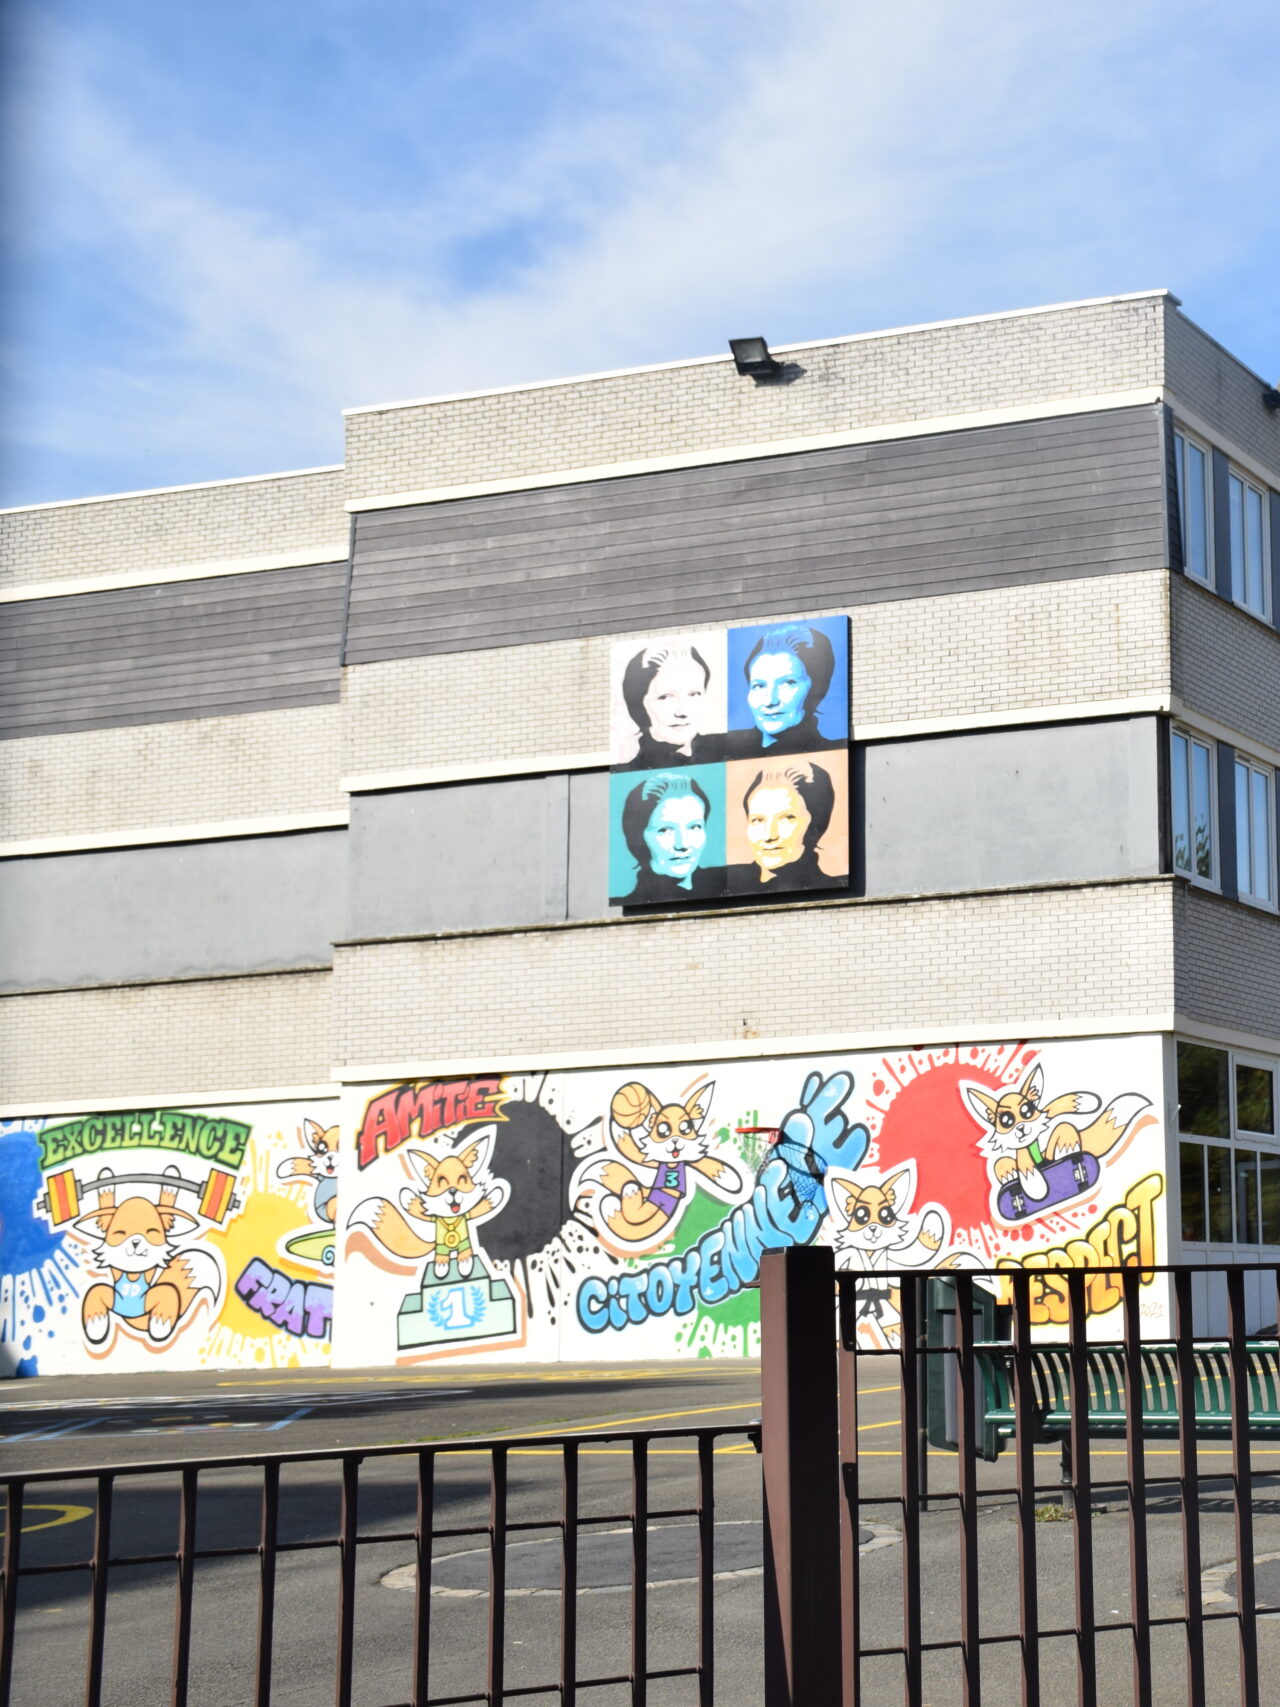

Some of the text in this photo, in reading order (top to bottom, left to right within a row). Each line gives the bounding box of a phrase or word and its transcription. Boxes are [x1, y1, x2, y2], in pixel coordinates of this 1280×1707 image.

[40, 1112, 251, 1170] EXCELLENCE
[665, 1171, 680, 1188] 3
[440, 1286, 475, 1331] 1
